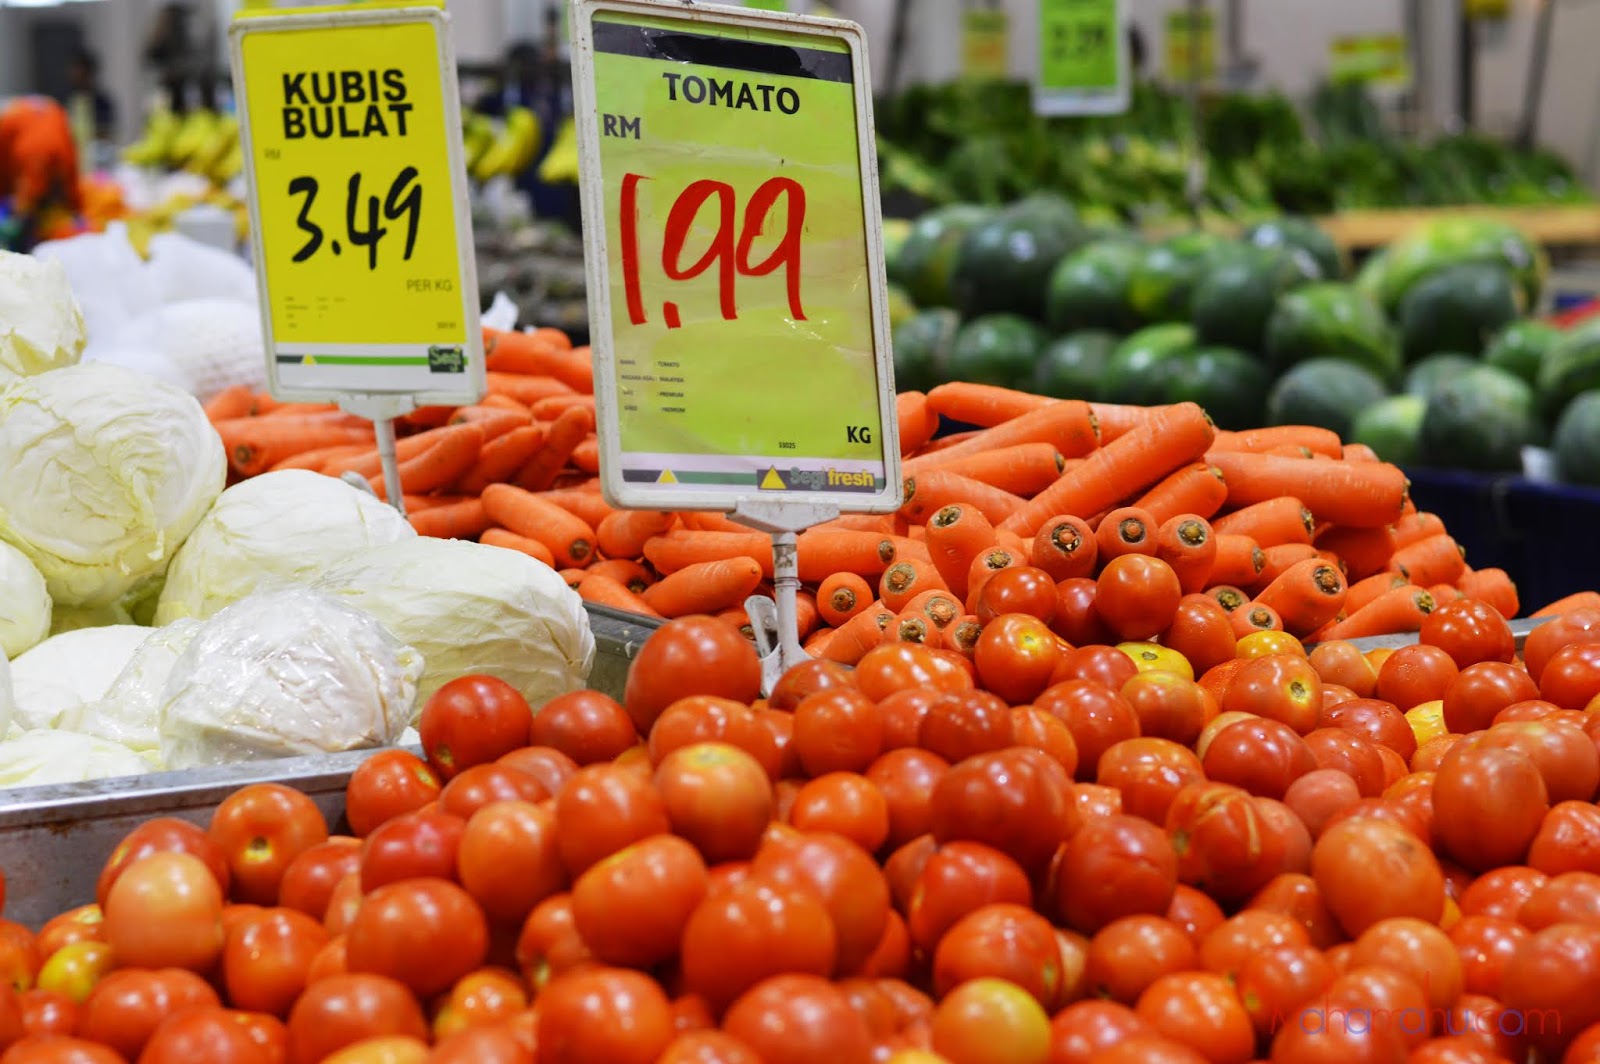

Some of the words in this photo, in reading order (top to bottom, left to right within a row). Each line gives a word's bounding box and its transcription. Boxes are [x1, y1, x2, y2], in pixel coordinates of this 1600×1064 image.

[282, 69, 407, 105] KUBIS
[663, 72, 801, 115] TOMATO
[282, 103, 413, 139] BULAT
[602, 113, 641, 139] RM
[288, 165, 422, 271] 3.49
[619, 172, 809, 330] 1.99
[406, 279, 431, 292] PER
[435, 279, 453, 292] KG
[846, 425, 873, 445] KG
[827, 466, 875, 488] fresh
